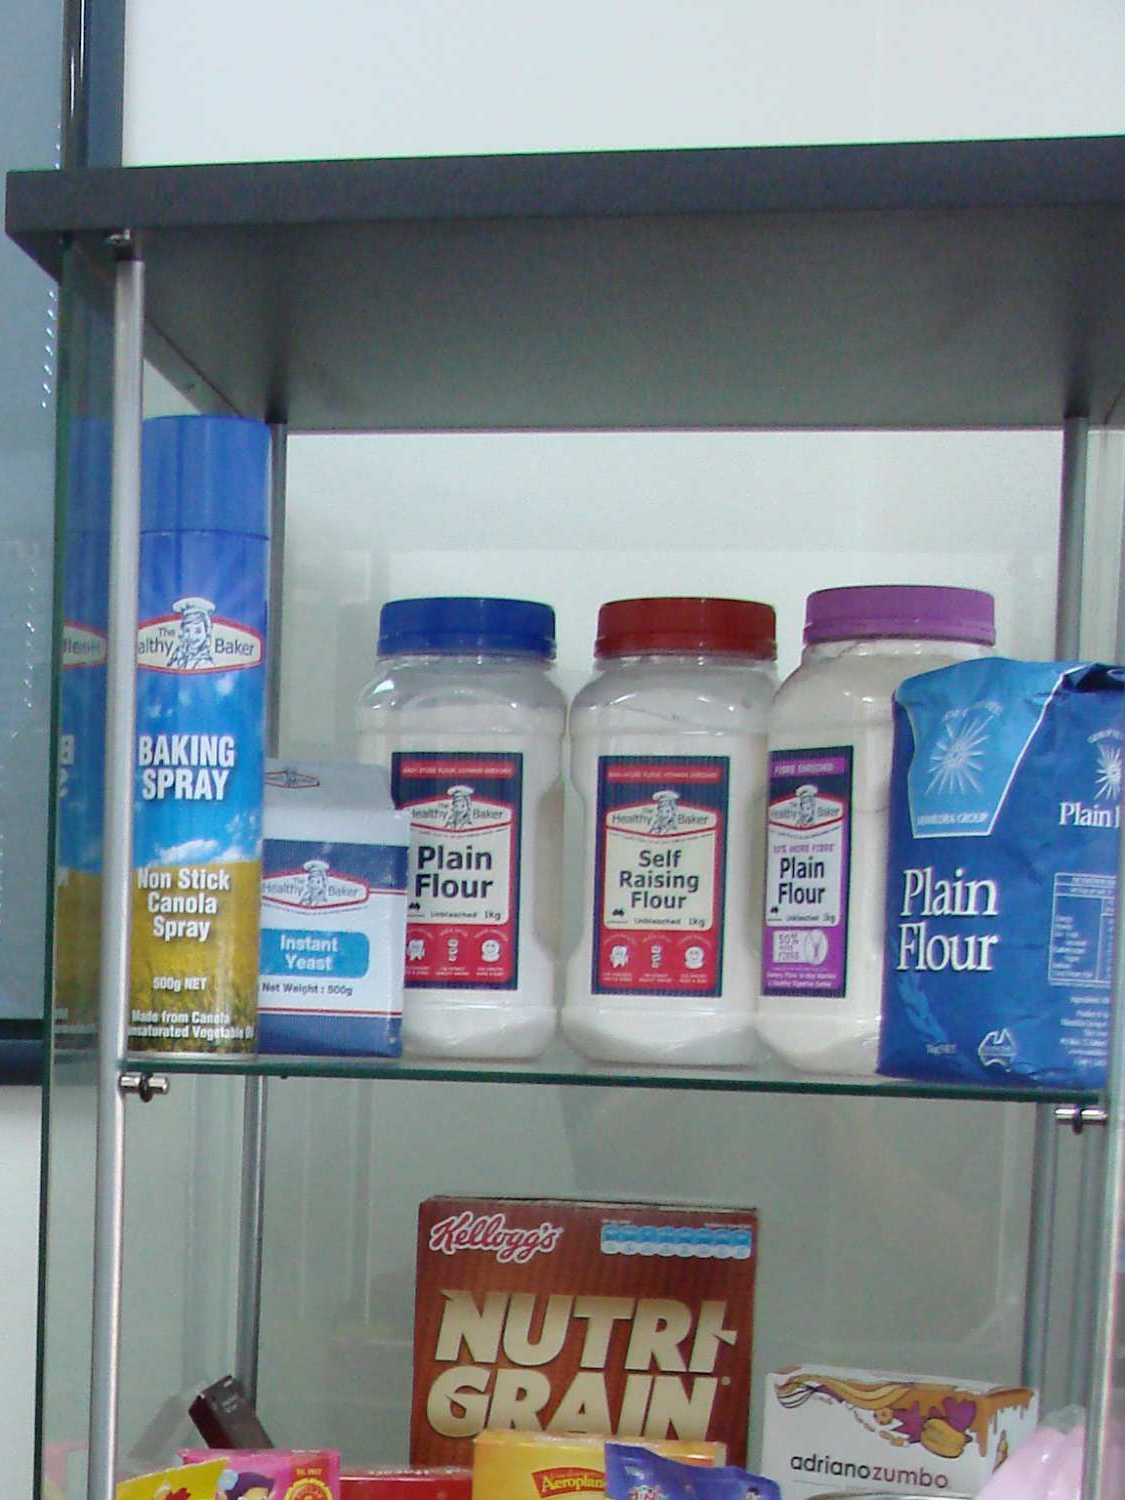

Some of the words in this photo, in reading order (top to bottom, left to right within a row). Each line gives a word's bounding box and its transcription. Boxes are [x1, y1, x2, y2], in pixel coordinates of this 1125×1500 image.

[138, 637, 174, 657] althy
[215, 638, 255, 657] Baker
[138, 735, 236, 767] BAKING
[142, 768, 230, 801] SPRAY
[473, 809, 504, 820] Baker
[611, 814, 652, 826] Healthy
[677, 813, 709, 825] Baker
[1059, 801, 1112, 829] Plain
[417, 845, 493, 871] Plain
[638, 849, 683, 868] Self
[779, 856, 825, 879] Plain
[137, 869, 172, 889] Non
[177, 868, 231, 891] Stick
[262, 881, 303, 898] Healthy
[327, 884, 359, 898] Baker
[415, 873, 494, 899] Flour
[619, 870, 700, 893] Raising
[631, 891, 687, 909] Flour
[778, 881, 826, 905] Flour
[900, 866, 1000, 917] Plain
[147, 892, 218, 914] Canola
[153, 915, 211, 942] Spray
[280, 934, 339, 953] Instant
[896, 921, 1001, 972] Flour
[284, 953, 333, 972] Yeast
[153, 976, 181, 992] 500g
[184, 976, 208, 990] NET
[262, 982, 280, 994] Net
[282, 983, 319, 996] Weight
[326, 985, 354, 998] 500g
[161, 1010, 189, 1024] from
[191, 1011, 231, 1024] Canola
[192, 1026, 243, 1041] Vegetable
[429, 1210, 564, 1264] Kellogg's
[426, 1365, 719, 1441] GRAIN
[541, 1473, 606, 1493] Aeroplan
